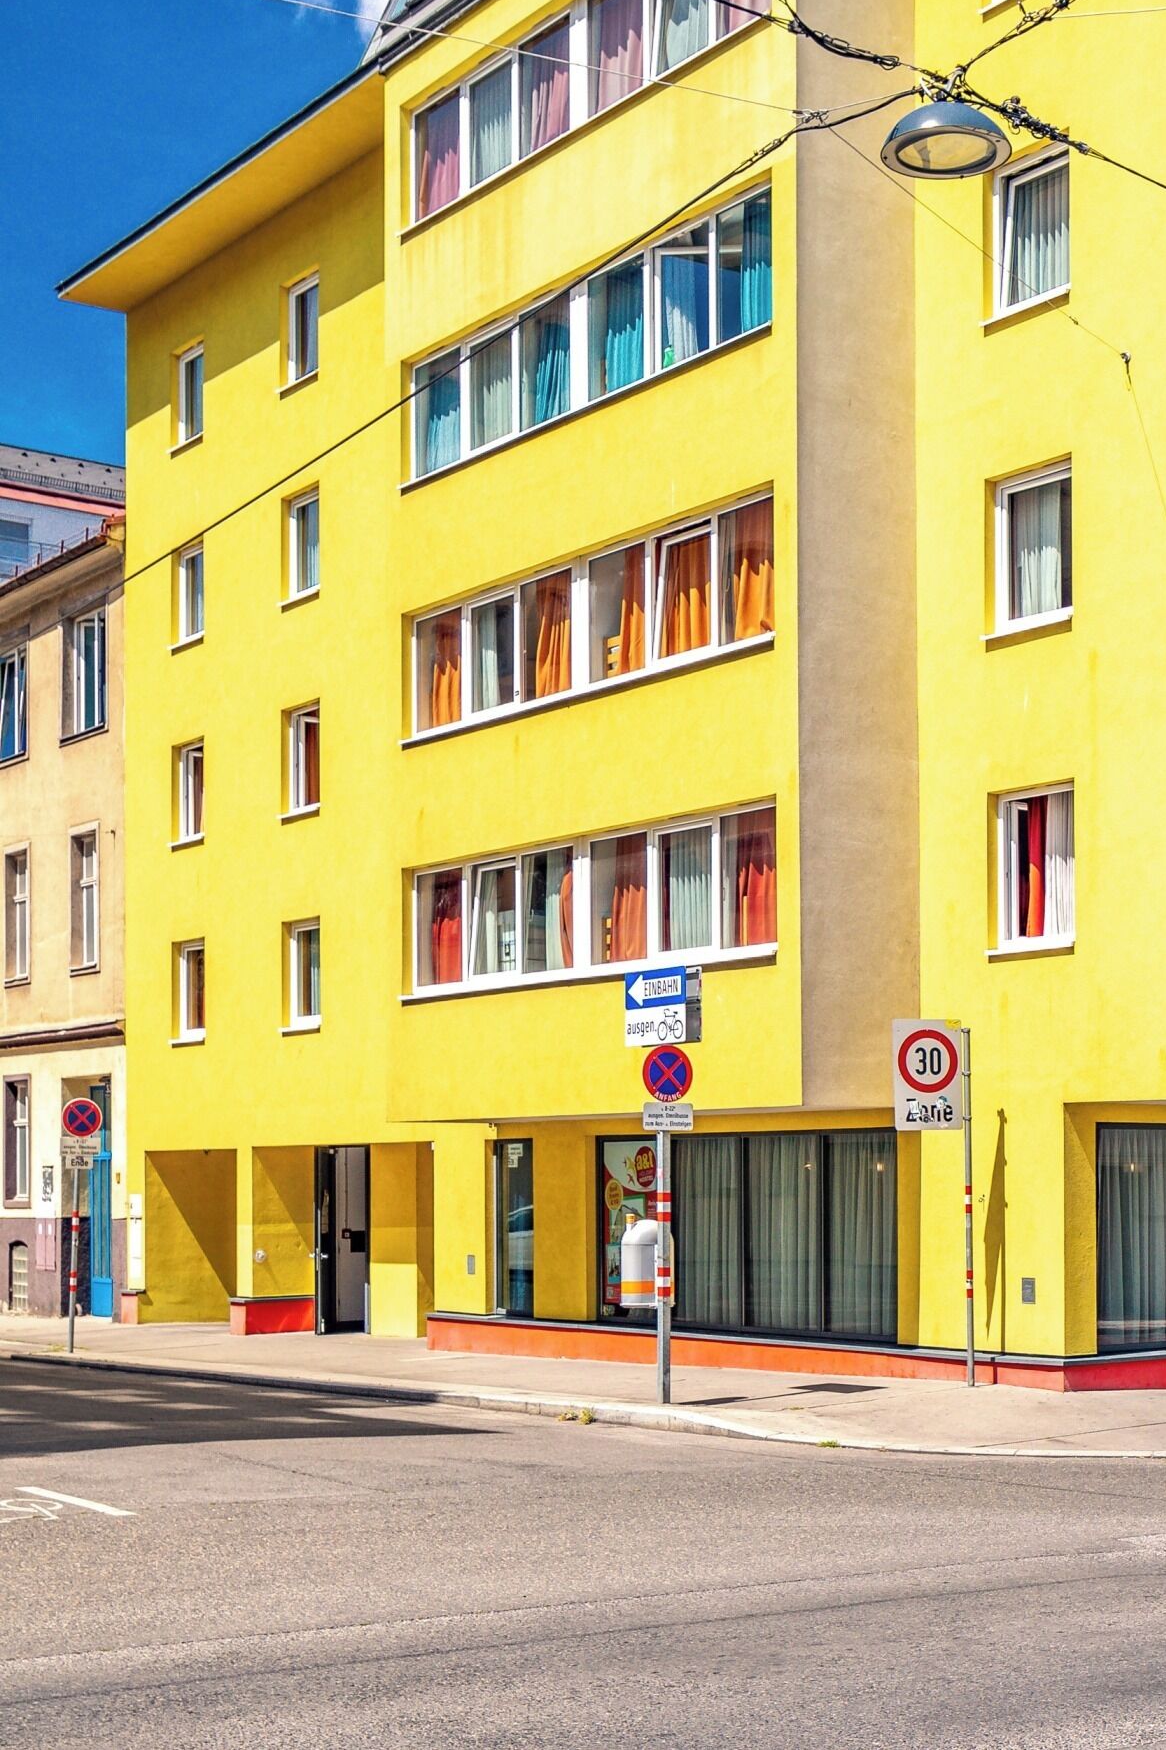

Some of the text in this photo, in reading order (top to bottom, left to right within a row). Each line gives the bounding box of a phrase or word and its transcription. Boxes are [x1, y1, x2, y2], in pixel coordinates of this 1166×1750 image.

[644, 978, 679, 997] EINBAHN
[627, 1021, 657, 1037] ausgen.
[915, 1047, 942, 1075] 30
[653, 1091, 682, 1102] ANFANG
